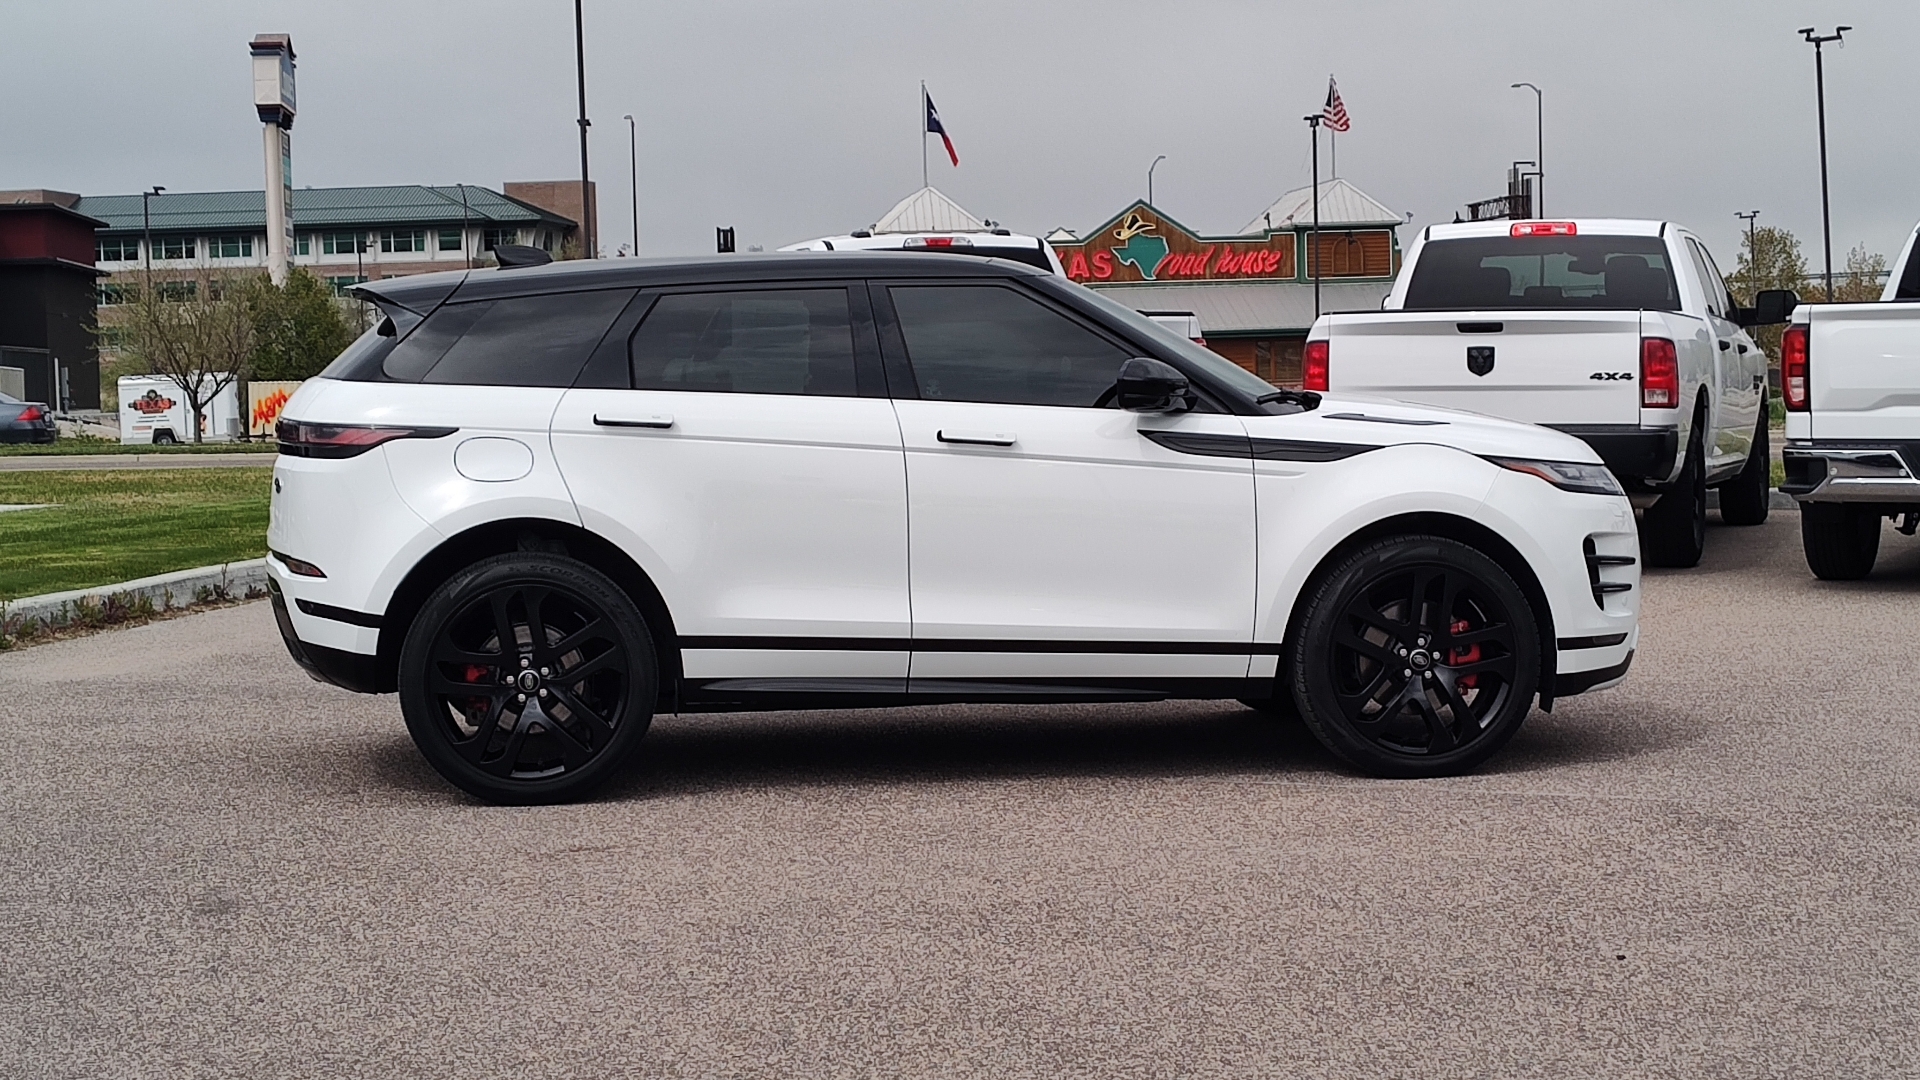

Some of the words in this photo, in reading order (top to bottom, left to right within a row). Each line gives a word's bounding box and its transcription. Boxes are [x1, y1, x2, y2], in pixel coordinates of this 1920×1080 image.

[1056, 250, 1114, 279] AS
[1153, 244, 1217, 277] road
[1213, 244, 1282, 276] house
